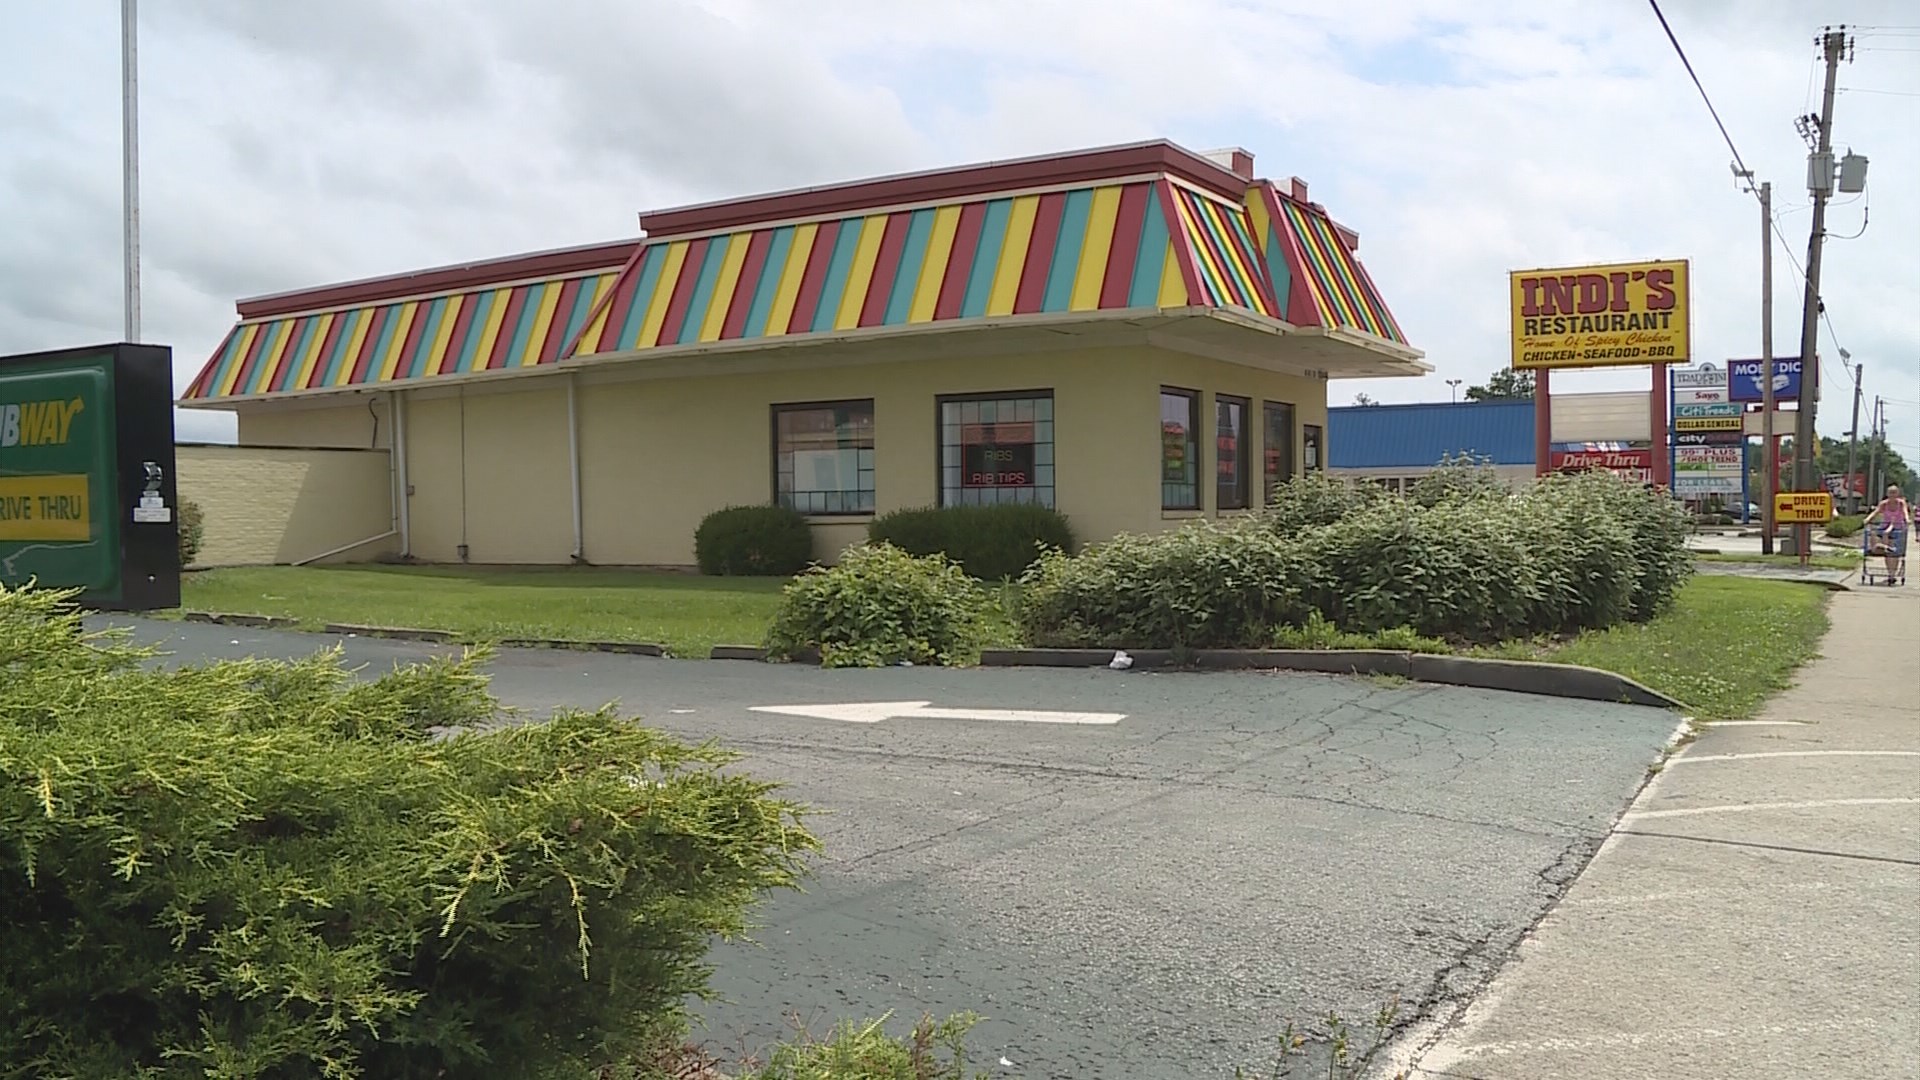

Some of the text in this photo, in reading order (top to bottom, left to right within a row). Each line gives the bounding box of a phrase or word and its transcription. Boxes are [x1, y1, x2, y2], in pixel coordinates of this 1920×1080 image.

[1521, 269, 1676, 317] INDI'S
[1524, 312, 1673, 336] RESTAURANT
[1564, 335, 1579, 348] Of
[1585, 335, 1620, 347] Spicy
[1625, 332, 1671, 346] Chicken
[1706, 420, 1740, 428] GENERAL
[984, 450, 1013, 461] RIBS
[1562, 453, 1640, 467] Drive Thru
[972, 472, 1025, 484] RIB TIPS
[38, 495, 81, 520] THRU
[1793, 496, 1826, 506] DRIVE
[1795, 509, 1824, 519] THRU
